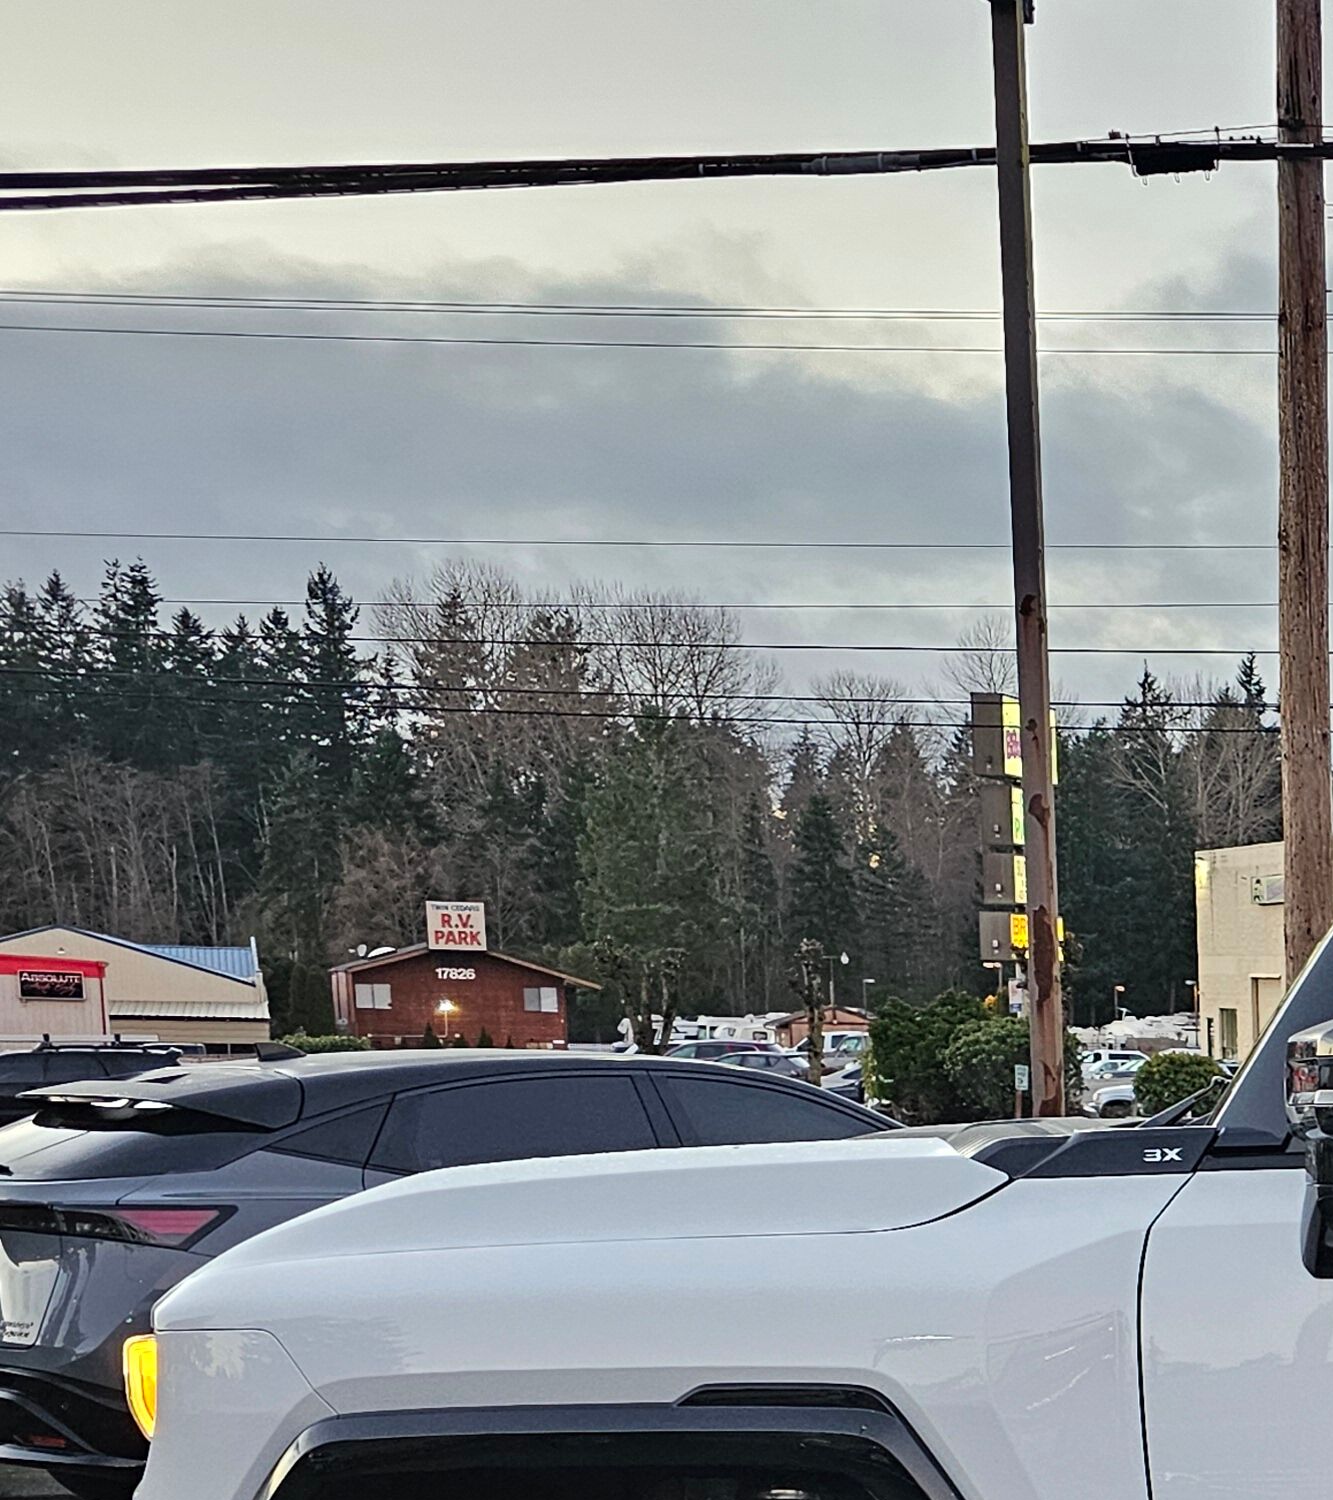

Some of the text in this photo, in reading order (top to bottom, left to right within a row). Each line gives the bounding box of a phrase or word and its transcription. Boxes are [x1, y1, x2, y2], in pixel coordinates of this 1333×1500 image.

[441, 913, 475, 929] R.V.
[434, 930, 482, 946] PARK
[435, 967, 476, 980] 17826
[1142, 1147, 1184, 1162] 3X
